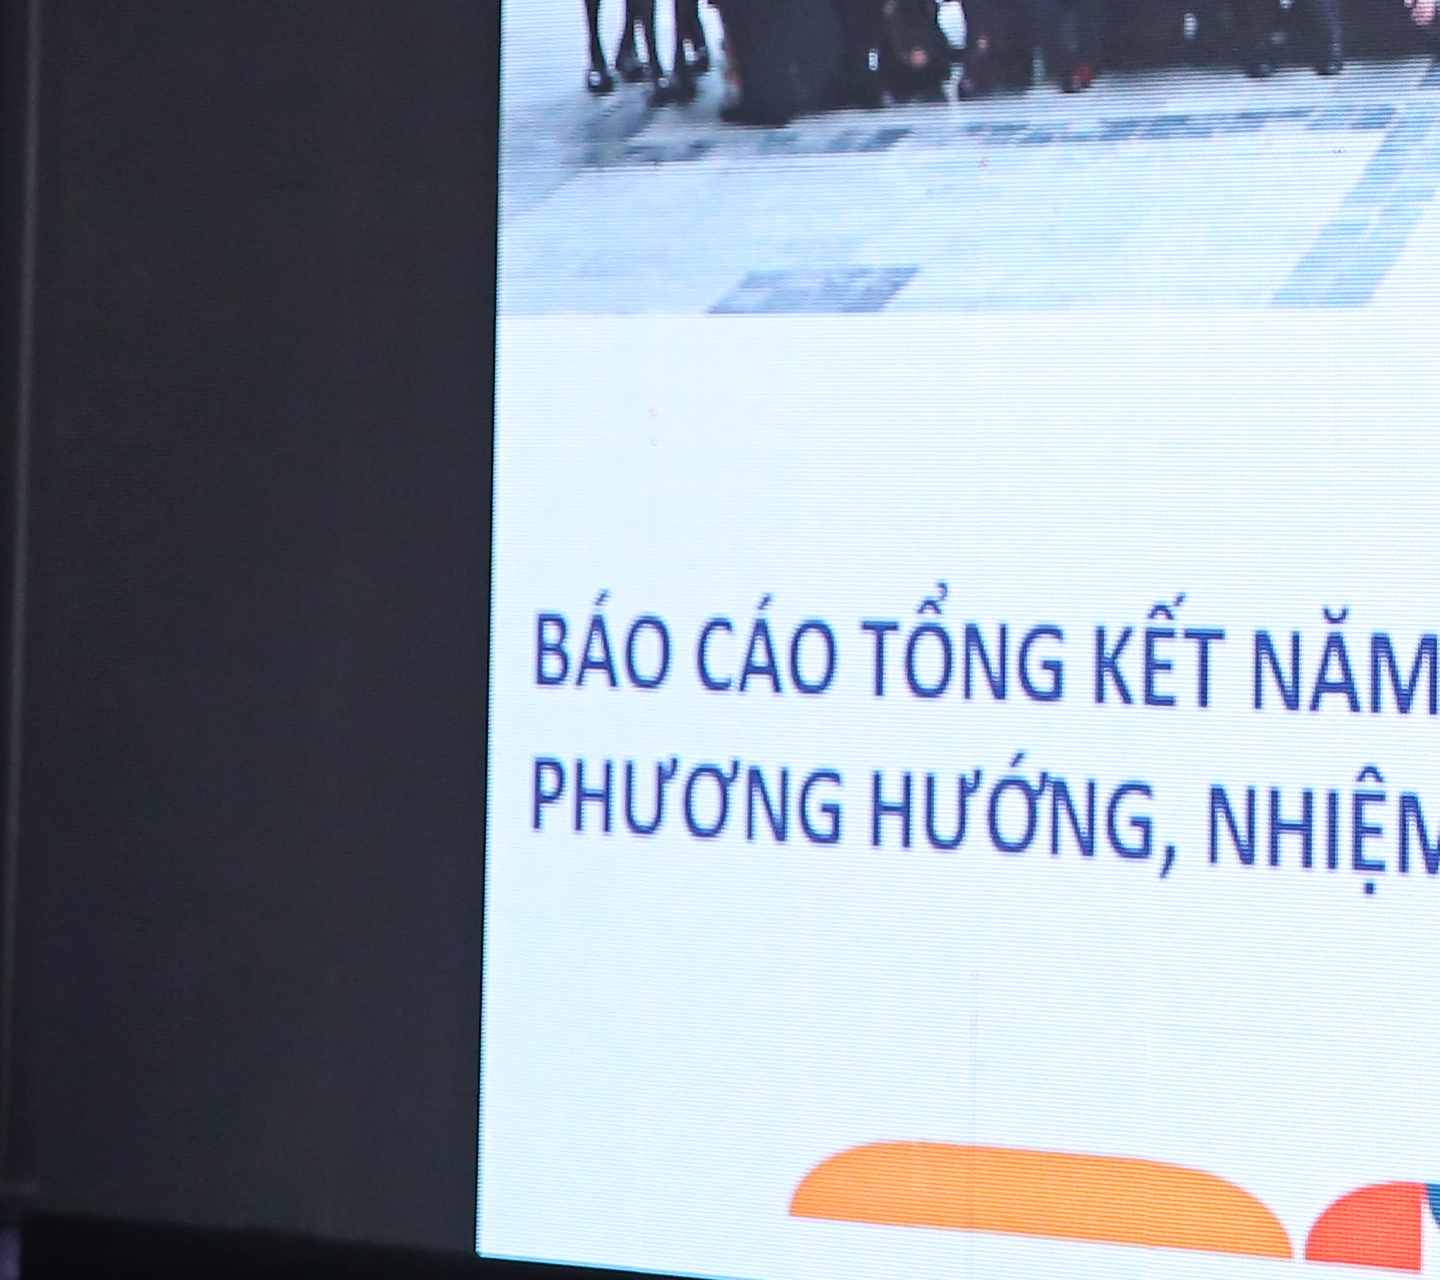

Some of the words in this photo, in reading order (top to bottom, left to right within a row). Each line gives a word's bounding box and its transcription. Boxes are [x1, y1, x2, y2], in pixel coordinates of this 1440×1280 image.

[533, 588, 671, 690] BÁO
[696, 593, 837, 696] CÁO
[862, 581, 1066, 703] TỔNG
[1095, 592, 1225, 709] KẾT
[1254, 604, 1440, 717] NĂM
[532, 755, 843, 846] PHƯƠNG
[872, 751, 1177, 879] HƯỚNG,
